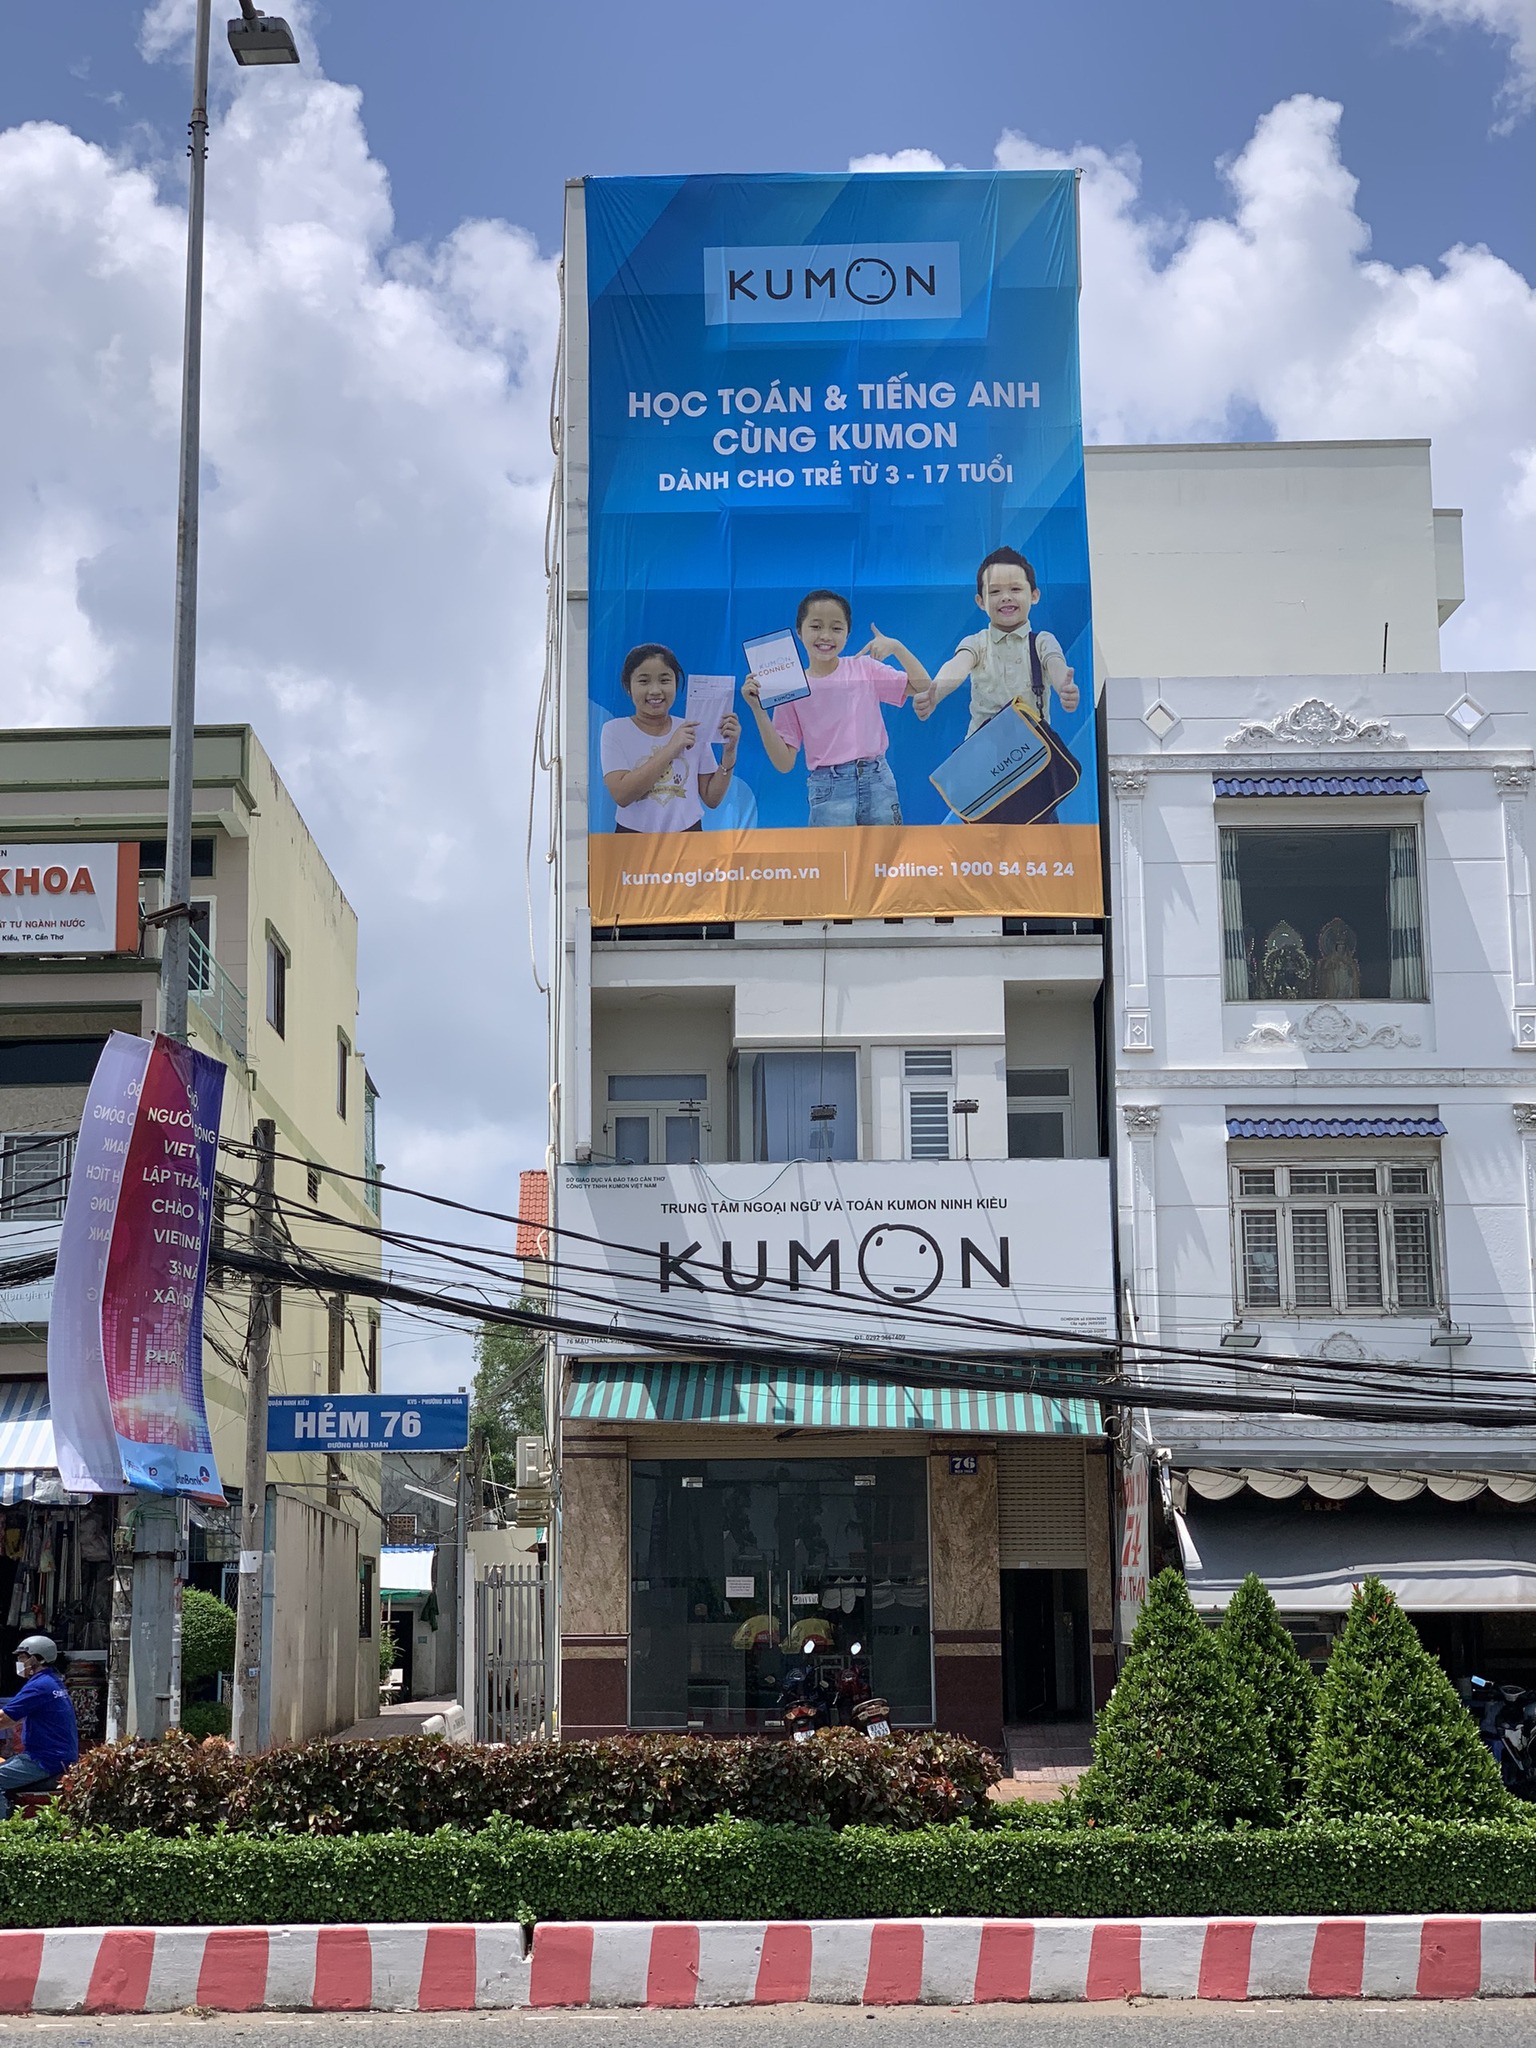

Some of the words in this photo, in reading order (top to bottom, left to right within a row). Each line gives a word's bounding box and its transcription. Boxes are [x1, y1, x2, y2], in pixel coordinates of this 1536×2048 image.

[728, 257, 936, 304] KUMON
[628, 392, 707, 425] HỌC
[717, 380, 812, 415] TOÁN
[824, 385, 847, 411] &
[858, 372, 956, 410] TIẾNG
[967, 382, 1041, 409] ANH
[713, 420, 817, 455] CÙNG
[829, 422, 958, 451] KUMON
[659, 465, 729, 492] DÀNH
[738, 468, 795, 489] CHO
[802, 461, 843, 487] TRẺ
[848, 460, 879, 486] TỪ
[885, 465, 900, 484] 3
[924, 464, 950, 484] 17
[961, 454, 1014, 484] TUỔI
[758, 661, 796, 677] CONNECT
[759, 656, 792, 670] KUMON
[990, 743, 1031, 777] KUMON
[621, 865, 821, 889] kumonglobal.com.vn
[874, 863, 944, 879] Hotline:
[949, 862, 995, 877] 1900
[999, 862, 1021, 877] 54
[1026, 862, 1048, 877] 54
[1052, 862, 1075, 877] 24
[9, 920, 22, 929] TƯ
[25, 917, 57, 929] NGÀNH
[60, 917, 86, 928] NƯỚC
[142, 1165, 172, 1187] LẬP
[151, 1197, 195, 1219] CHÀO
[661, 1202, 708, 1215] TRUNG
[711, 1201, 740, 1214] TÂM
[743, 1201, 787, 1217] NGOẠI
[790, 1199, 821, 1213] NGỮ
[824, 1198, 843, 1212] VÀ
[846, 1199, 885, 1211] TOÁN
[887, 1200, 938, 1211] KUMON
[941, 1199, 971, 1211] NINH
[975, 1197, 1009, 1210] KIỀU
[660, 1223, 1010, 1303] KUMON
[295, 1402, 369, 1438] HẺM
[381, 1411, 421, 1437] 76
[952, 1457, 976, 1469] 76
